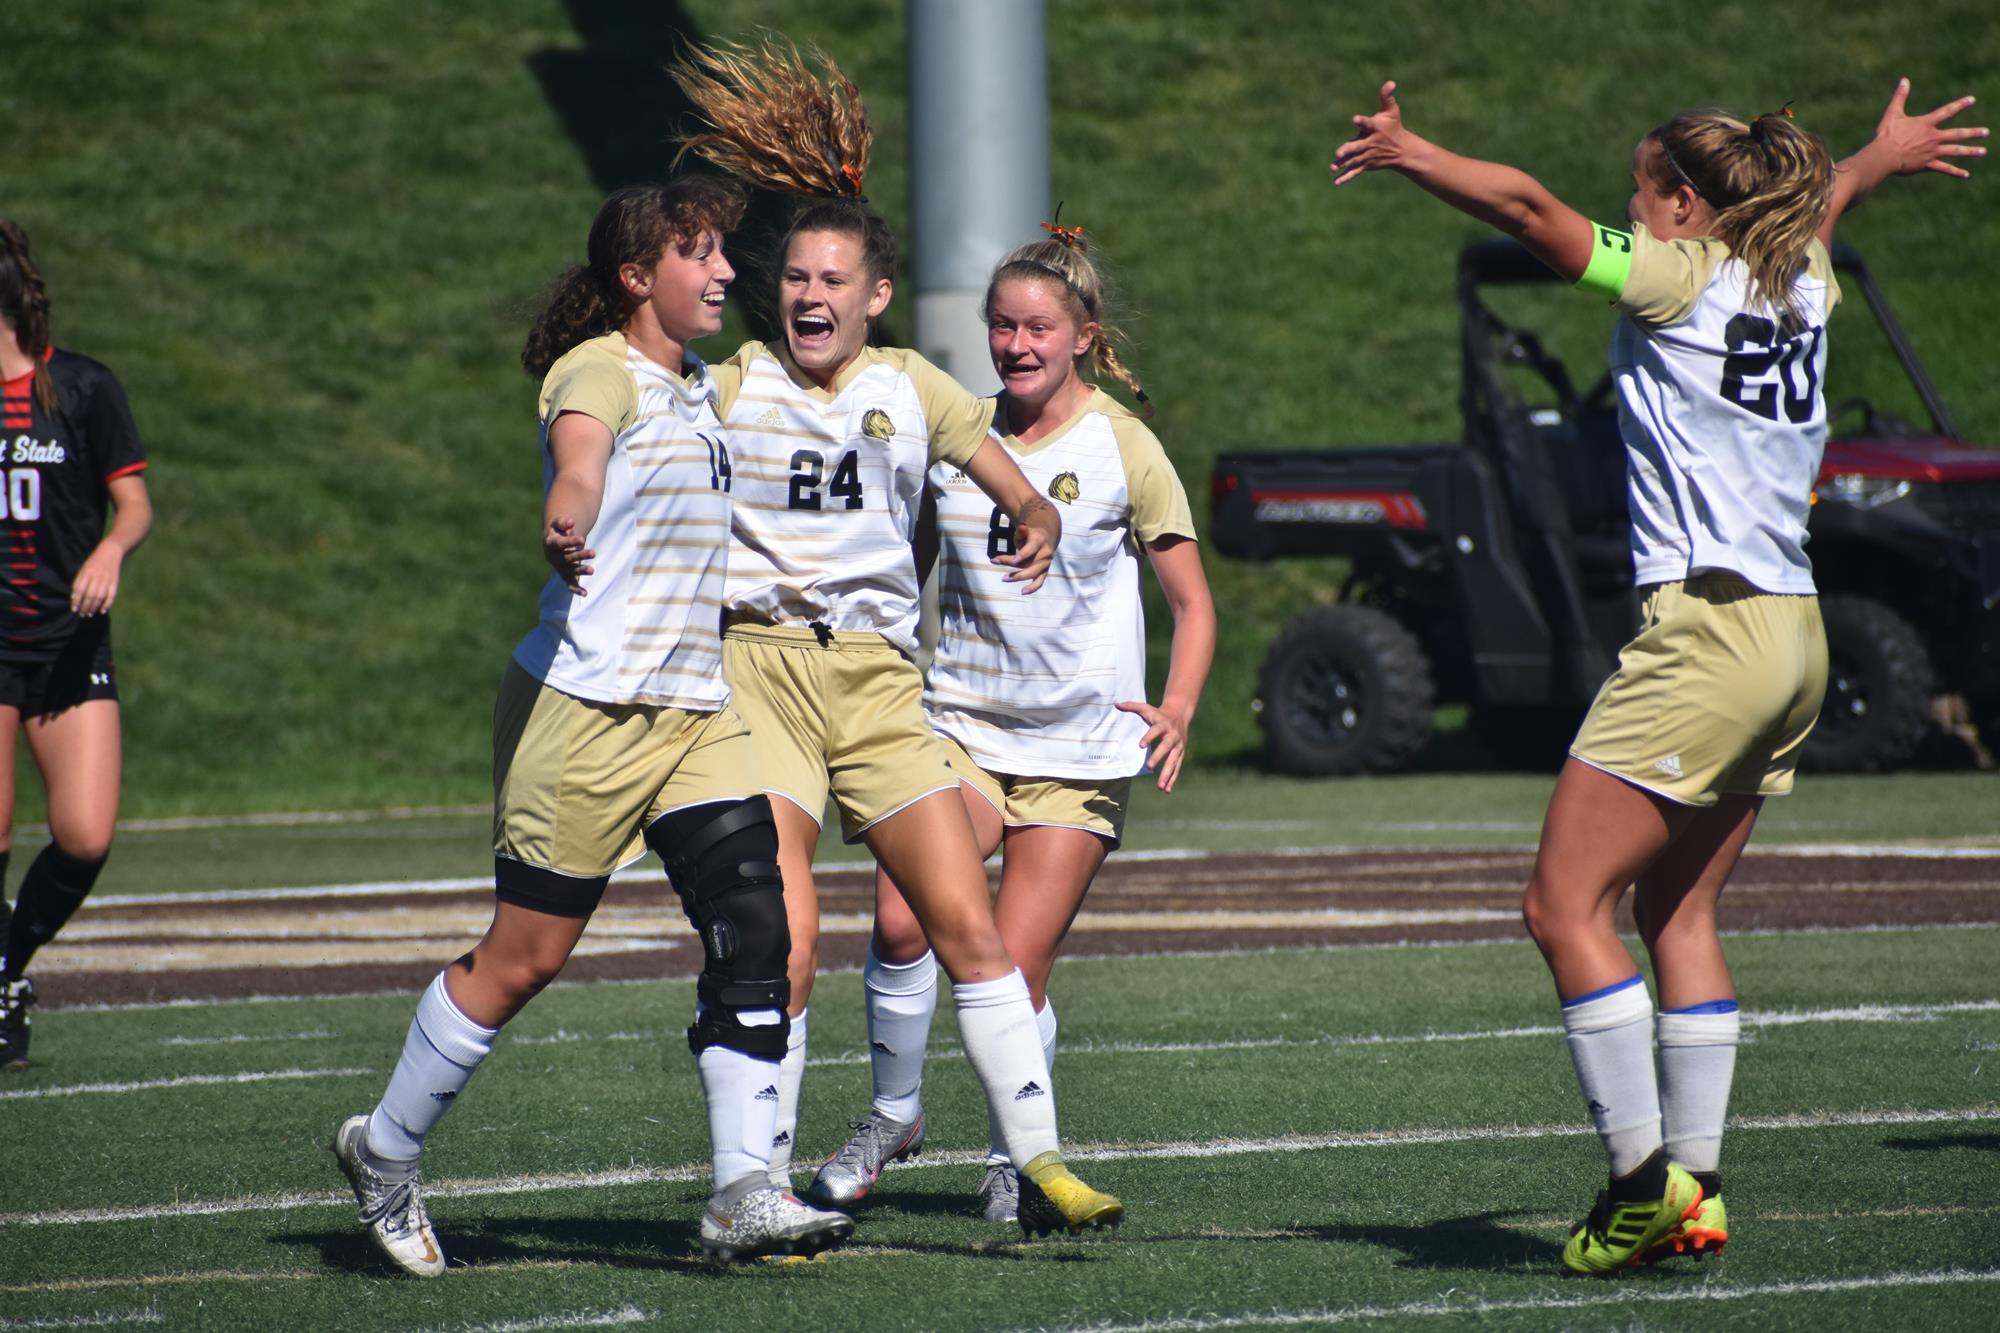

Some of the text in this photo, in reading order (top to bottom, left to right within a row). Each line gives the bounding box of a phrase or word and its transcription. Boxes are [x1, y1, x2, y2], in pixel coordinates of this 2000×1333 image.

[1600, 227, 1631, 253] C
[1719, 312, 1822, 424] 20
[12, 434, 65, 464] State
[696, 432, 731, 493] 14
[0, 468, 41, 521] 0
[788, 449, 863, 511] 24
[987, 505, 1017, 562] 8
[1014, 1090, 1045, 1101] adidas
